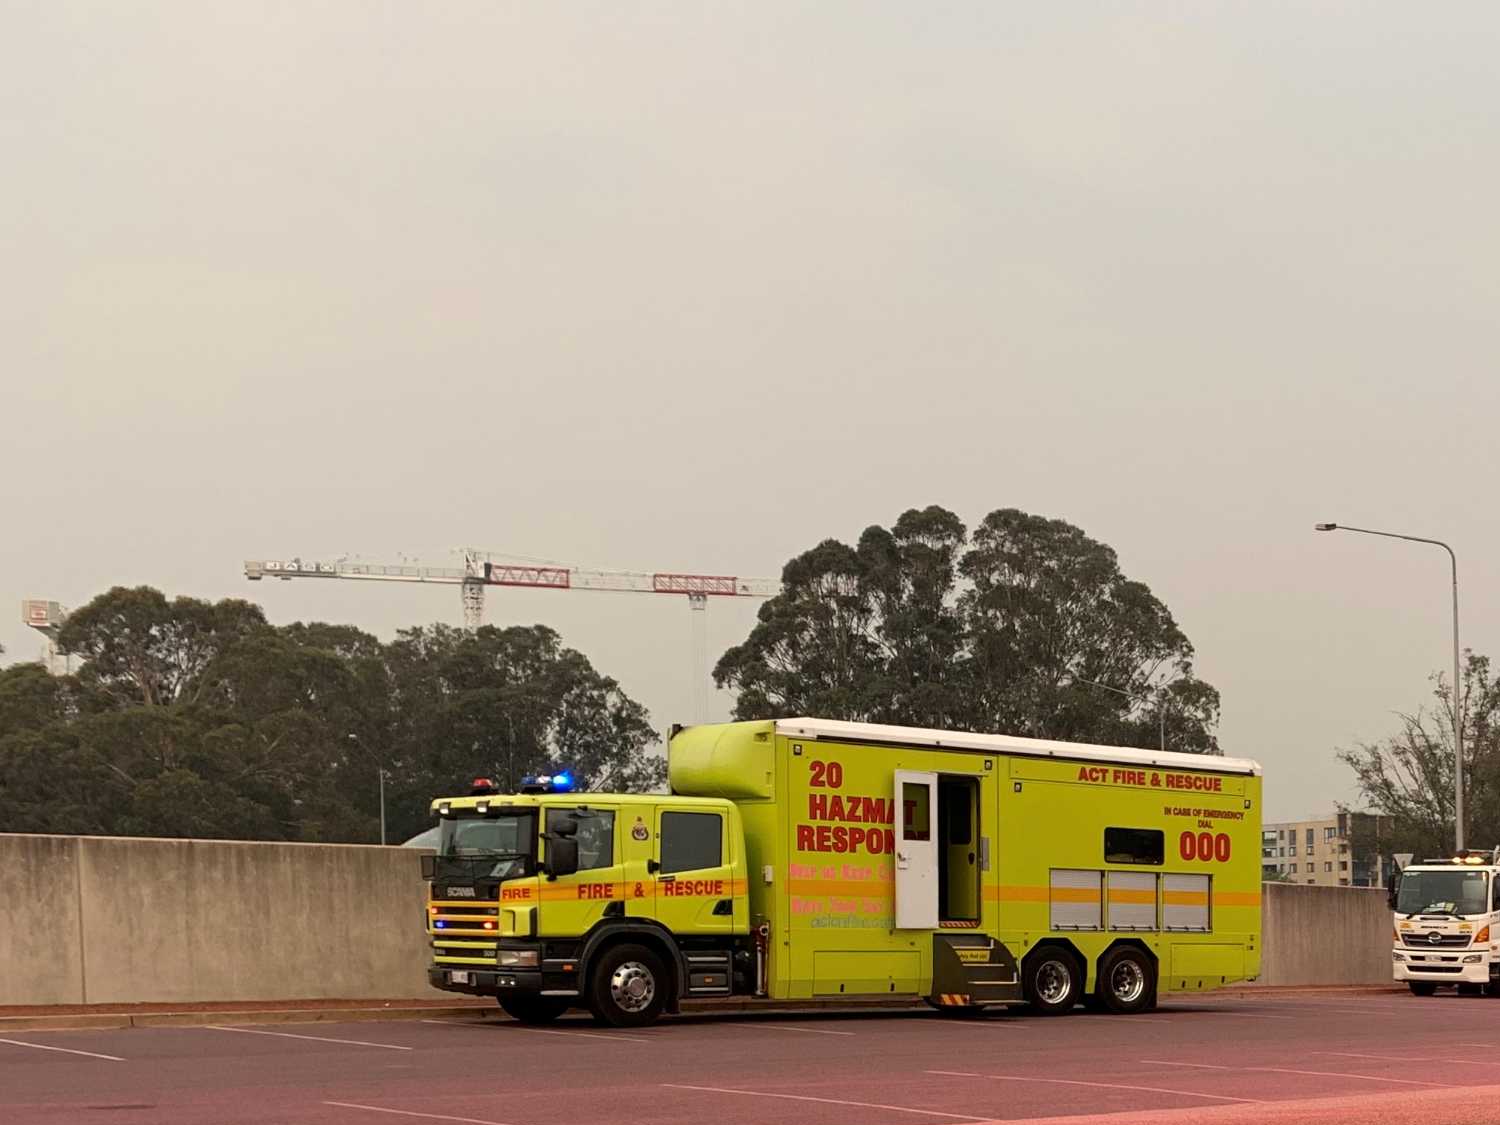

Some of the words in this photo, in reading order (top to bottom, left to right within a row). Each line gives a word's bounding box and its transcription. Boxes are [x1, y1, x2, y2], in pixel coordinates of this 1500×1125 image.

[809, 761, 843, 788] 20
[1078, 766, 1109, 783] ACT
[1112, 769, 1146, 786] FIRE
[1150, 772, 1162, 787] &
[1165, 773, 1222, 792] RESCUE
[1164, 806, 1171, 816] IN
[1172, 807, 1191, 817] CASE
[1192, 809, 1202, 817] OF
[1203, 809, 1245, 821] EMERGENCY
[1197, 819, 1213, 829] DIAL
[1180, 831, 1231, 863] 000
[447, 886, 476, 898] SCANIA
[502, 888, 531, 900] FIRE
[577, 883, 614, 900] FIRE
[633, 882, 645, 898] &
[664, 880, 723, 897] RESCUE
